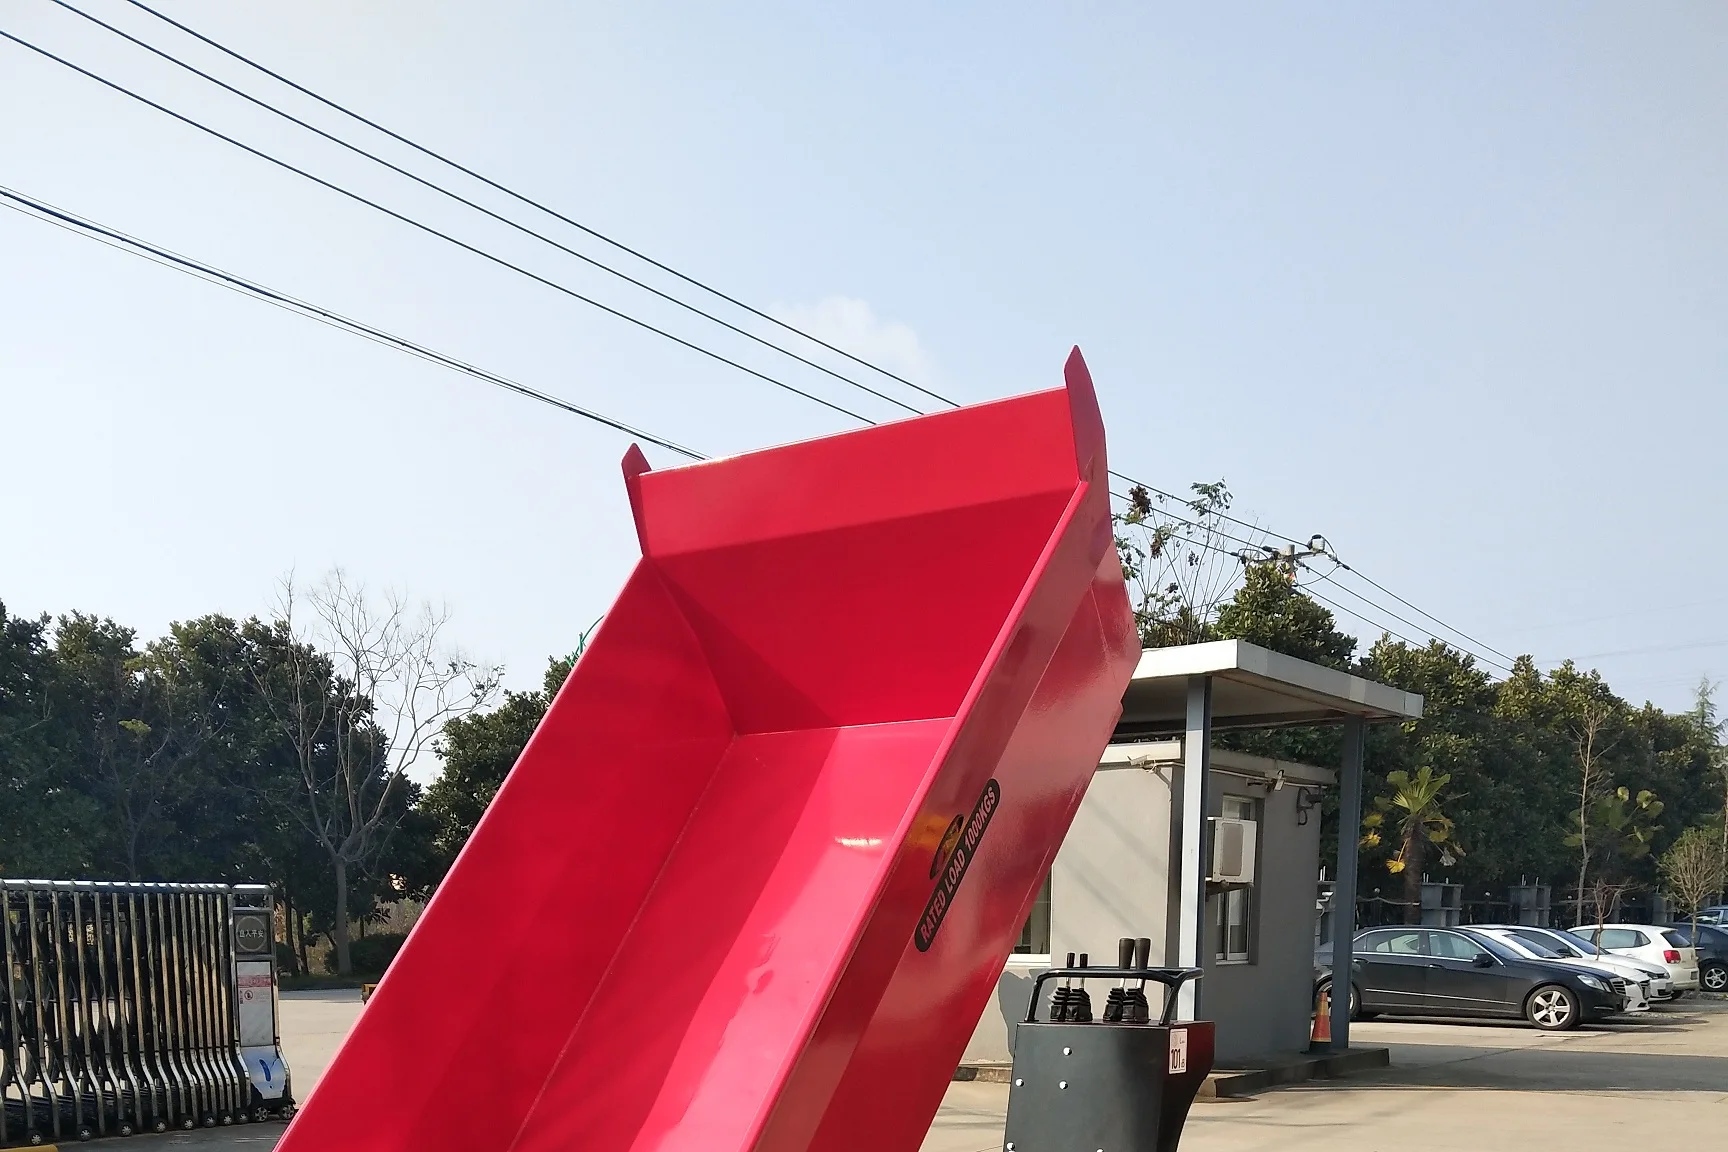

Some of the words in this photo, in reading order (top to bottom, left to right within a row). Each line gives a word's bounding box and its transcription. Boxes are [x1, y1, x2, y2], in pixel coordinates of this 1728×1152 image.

[920, 889, 946, 943] RATED
[945, 848, 966, 894] LOAD
[964, 786, 996, 851] 1000KGS
[1170, 1048, 1181, 1069] 101
